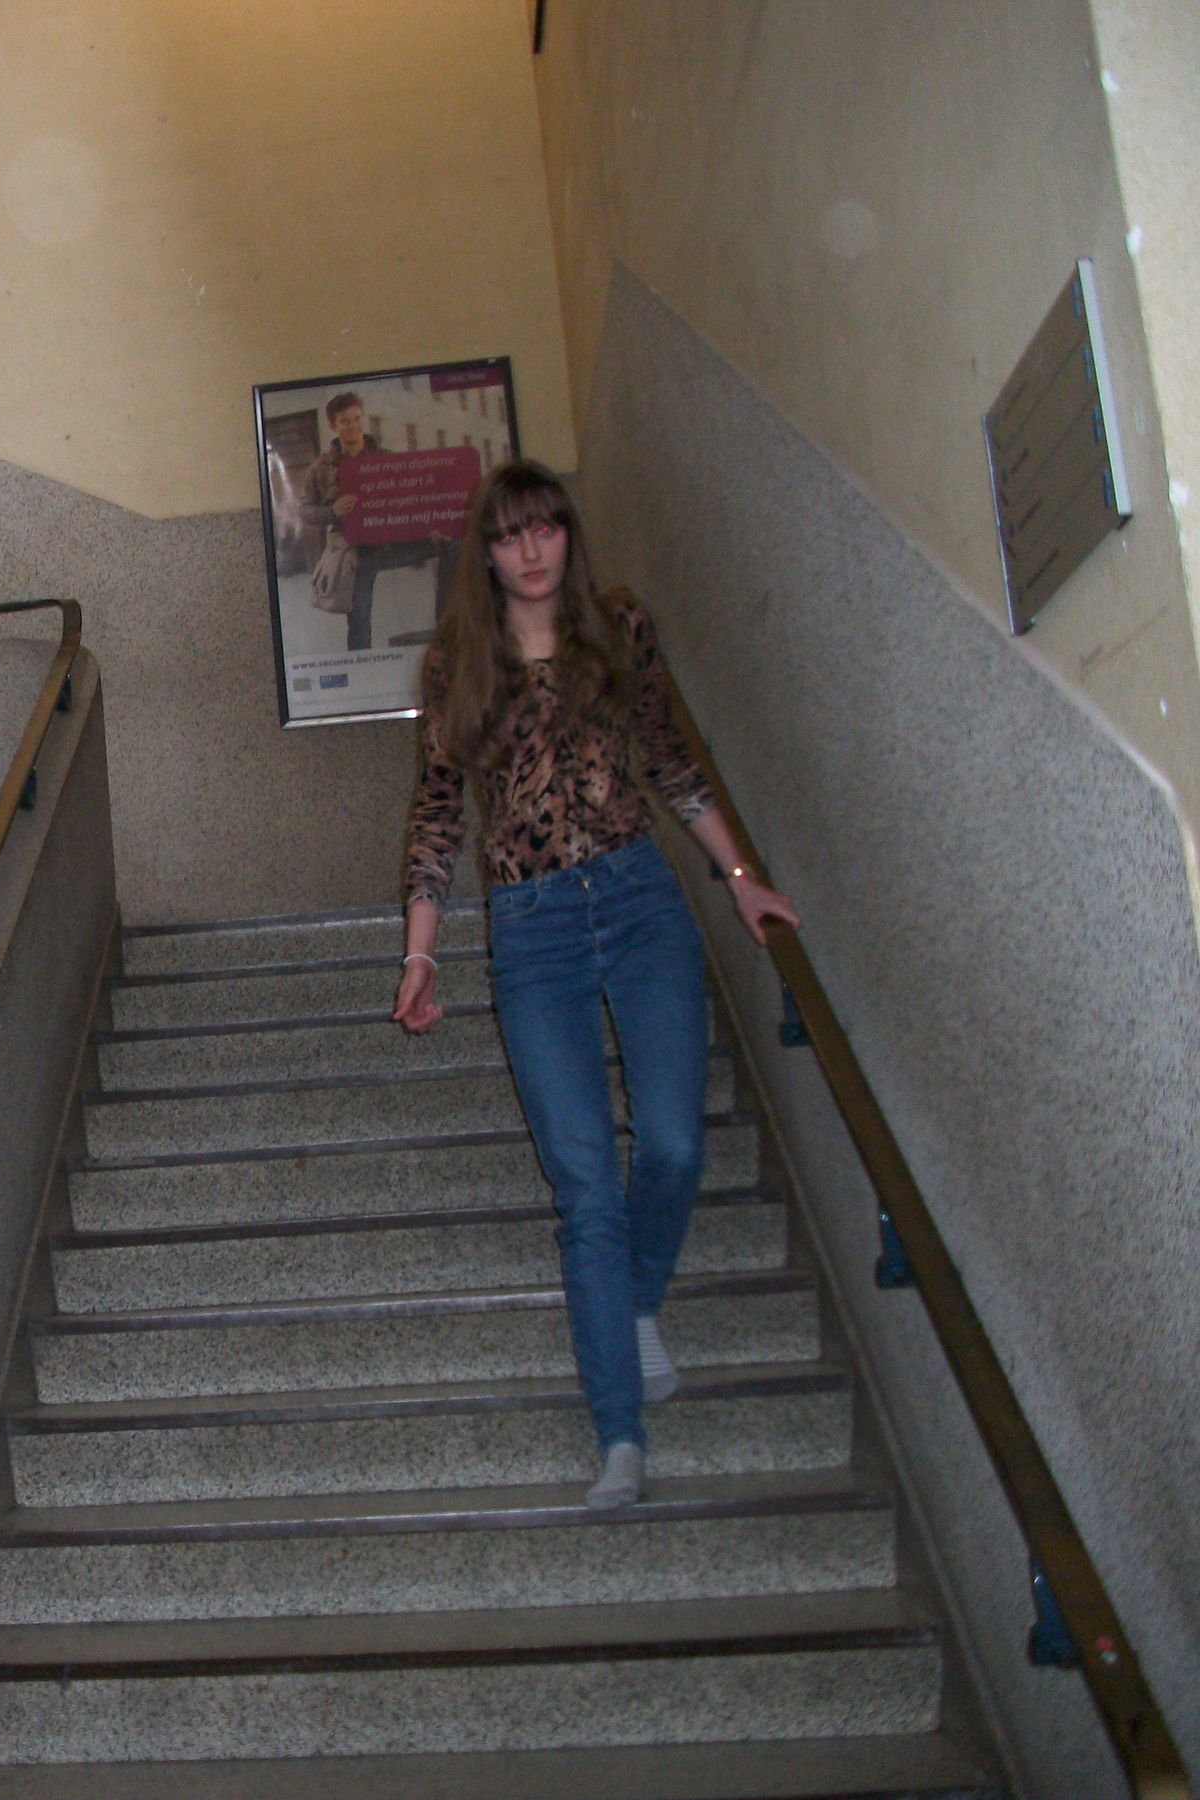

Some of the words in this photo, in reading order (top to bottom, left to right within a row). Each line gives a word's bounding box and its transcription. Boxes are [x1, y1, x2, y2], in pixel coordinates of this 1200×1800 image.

[408, 456, 456, 470] diploma
[360, 483, 374, 493] op
[398, 476, 424, 488] start
[360, 499, 386, 509] voor
[388, 495, 418, 509] eigen
[362, 516, 385, 528] Wie
[387, 513, 409, 525] kan
[412, 512, 431, 525] mij
